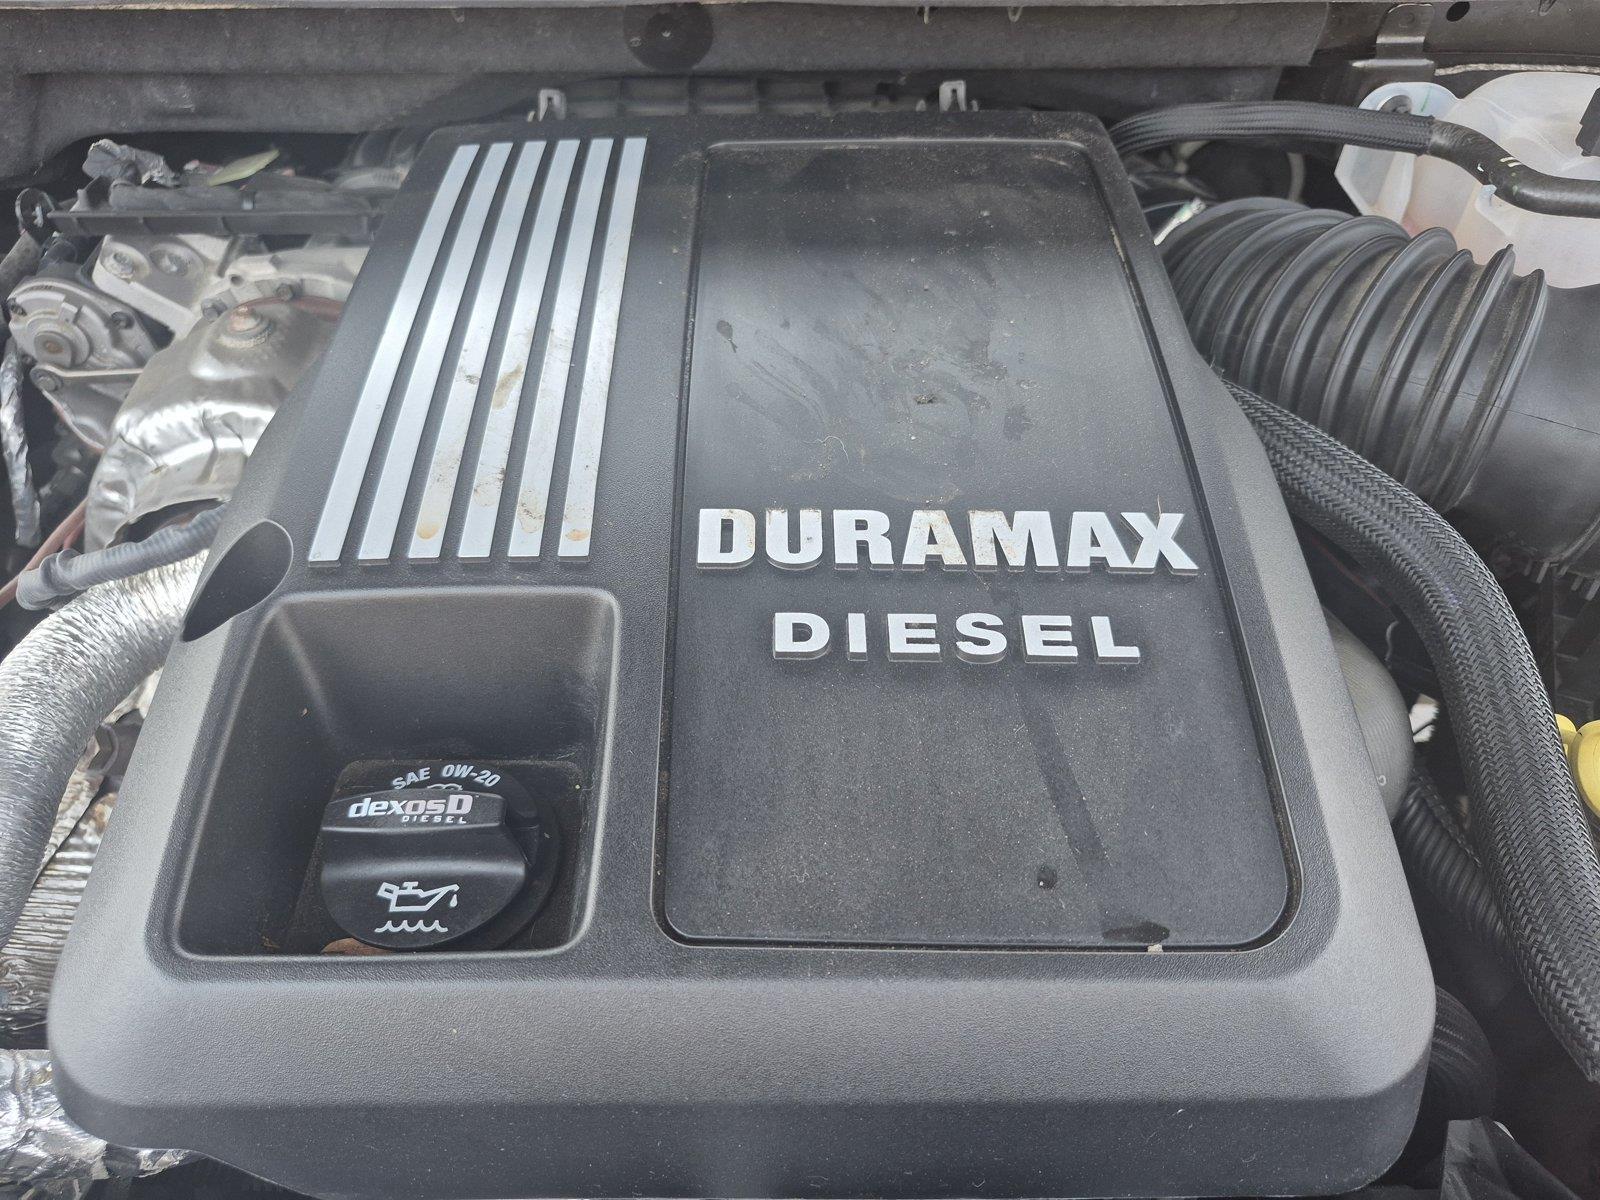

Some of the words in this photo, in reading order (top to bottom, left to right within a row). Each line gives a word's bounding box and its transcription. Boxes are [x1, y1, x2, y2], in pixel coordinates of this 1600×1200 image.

[696, 508, 1198, 575] DURAMAX
[772, 612, 1140, 662] DIESEL
[391, 767, 431, 790] SAE
[440, 763, 501, 787] 0W-20
[347, 794, 473, 818] dexosD
[401, 814, 467, 824] DIESEL
